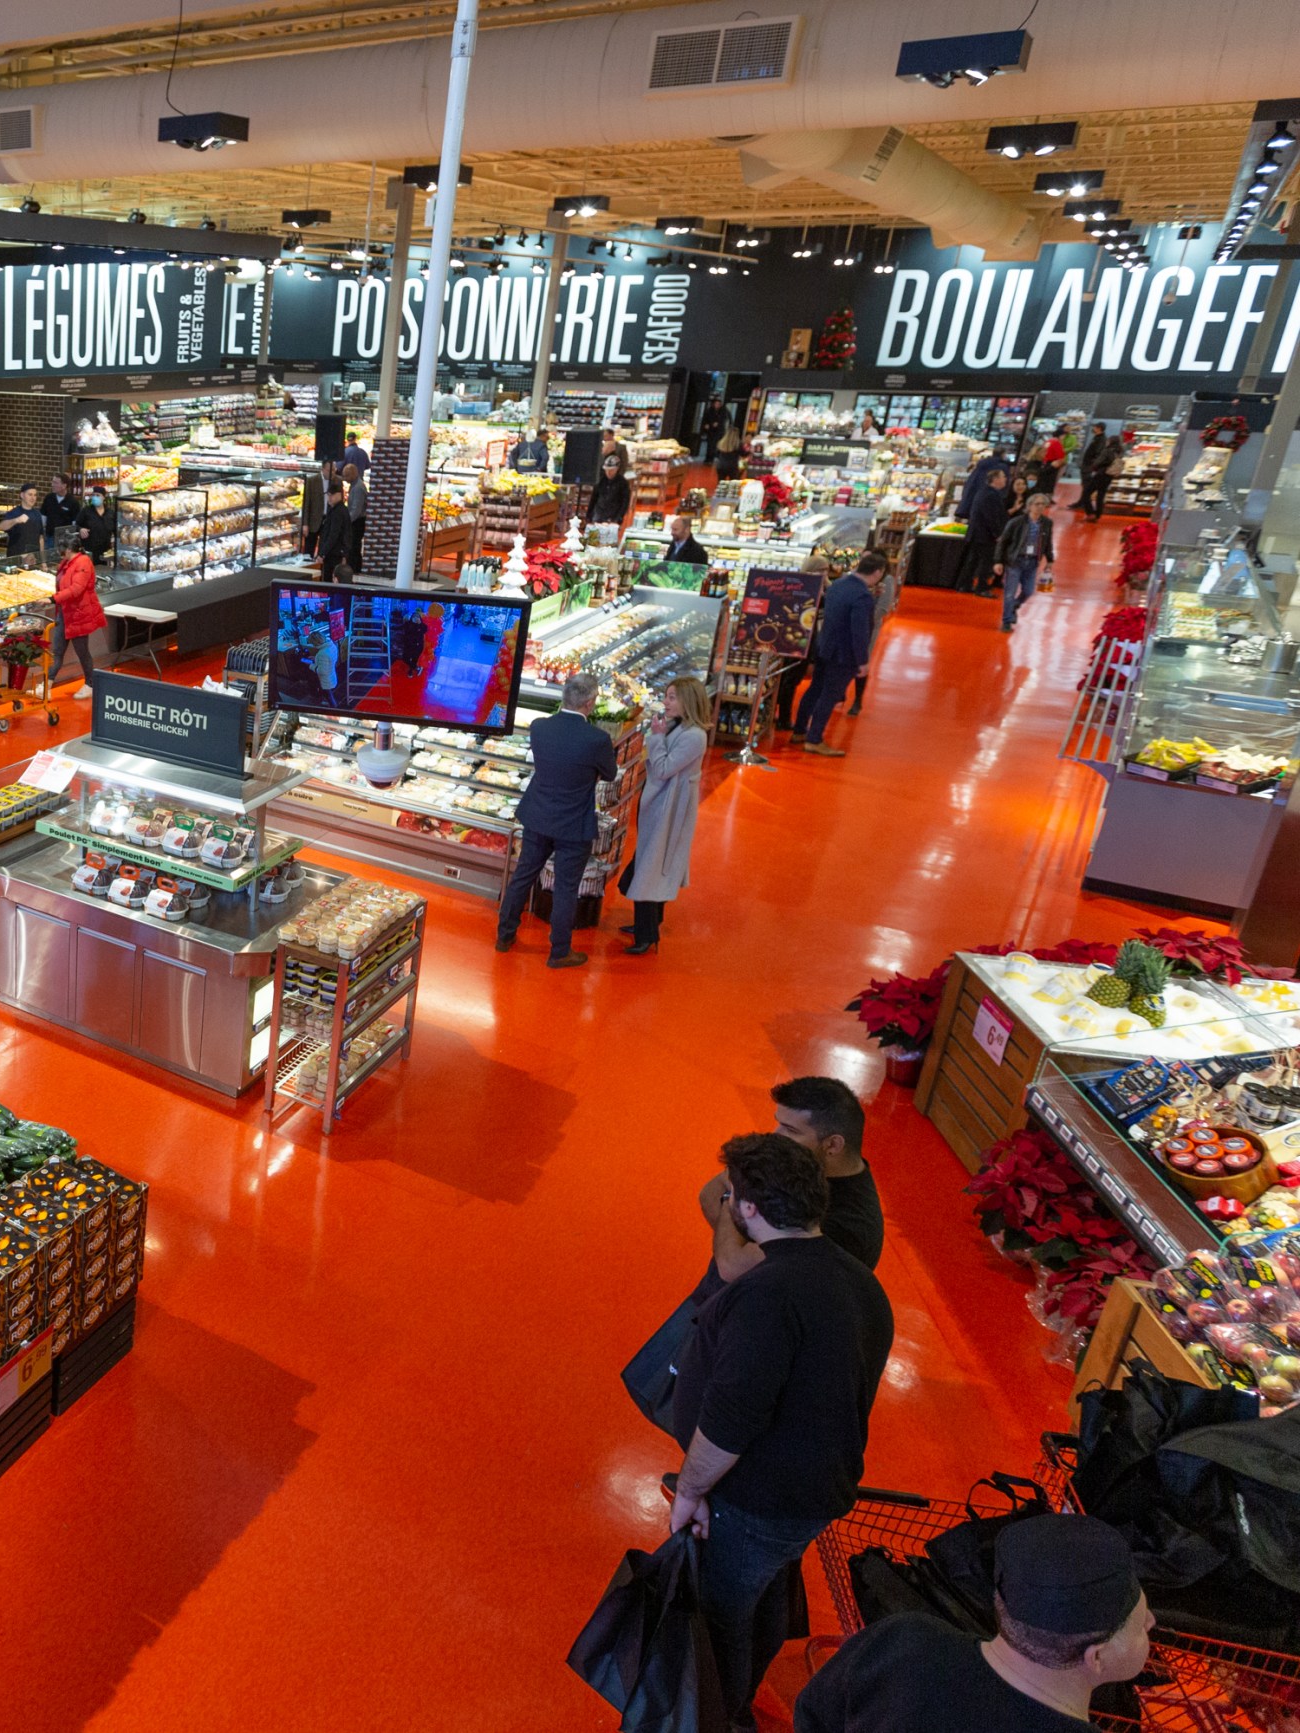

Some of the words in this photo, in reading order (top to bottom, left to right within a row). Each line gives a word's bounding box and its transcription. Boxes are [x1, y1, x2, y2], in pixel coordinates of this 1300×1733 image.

[180, 294, 192, 306] &
[3, 262, 166, 371] LÉGUMES
[189, 267, 208, 363] VEGETABLES
[332, 275, 644, 364] POSONNRIE
[641, 274, 691, 364] SEAFOOD
[177, 309, 192, 364] FRUITS
[104, 695, 166, 721] POULET
[169, 706, 208, 730] RÔTI
[104, 711, 151, 729] ROTISSERIE
[152, 720, 189, 737] CHICKEN
[49, 828, 76, 842] Poulet
[91, 841, 143, 863] Simplement
[88, 1203, 110, 1225] ROXY
[121, 1201, 141, 1223] ROXY
[51, 1234, 72, 1257] ROXY
[87, 1229, 108, 1251] ROXY
[119, 1227, 138, 1248] ROXY
[51, 1258, 73, 1282] ROXY
[87, 1253, 107, 1278] ROXY
[118, 1250, 137, 1273] ROXY
[11, 1265, 36, 1291] ROXY
[87, 1277, 106, 1301] ROXY
[115, 1274, 135, 1296] ROXY
[11, 1291, 36, 1316] ROXY
[50, 1283, 72, 1309] ROXY
[84, 1303, 104, 1326] ROXY
[10, 1316, 35, 1344] ROXY
